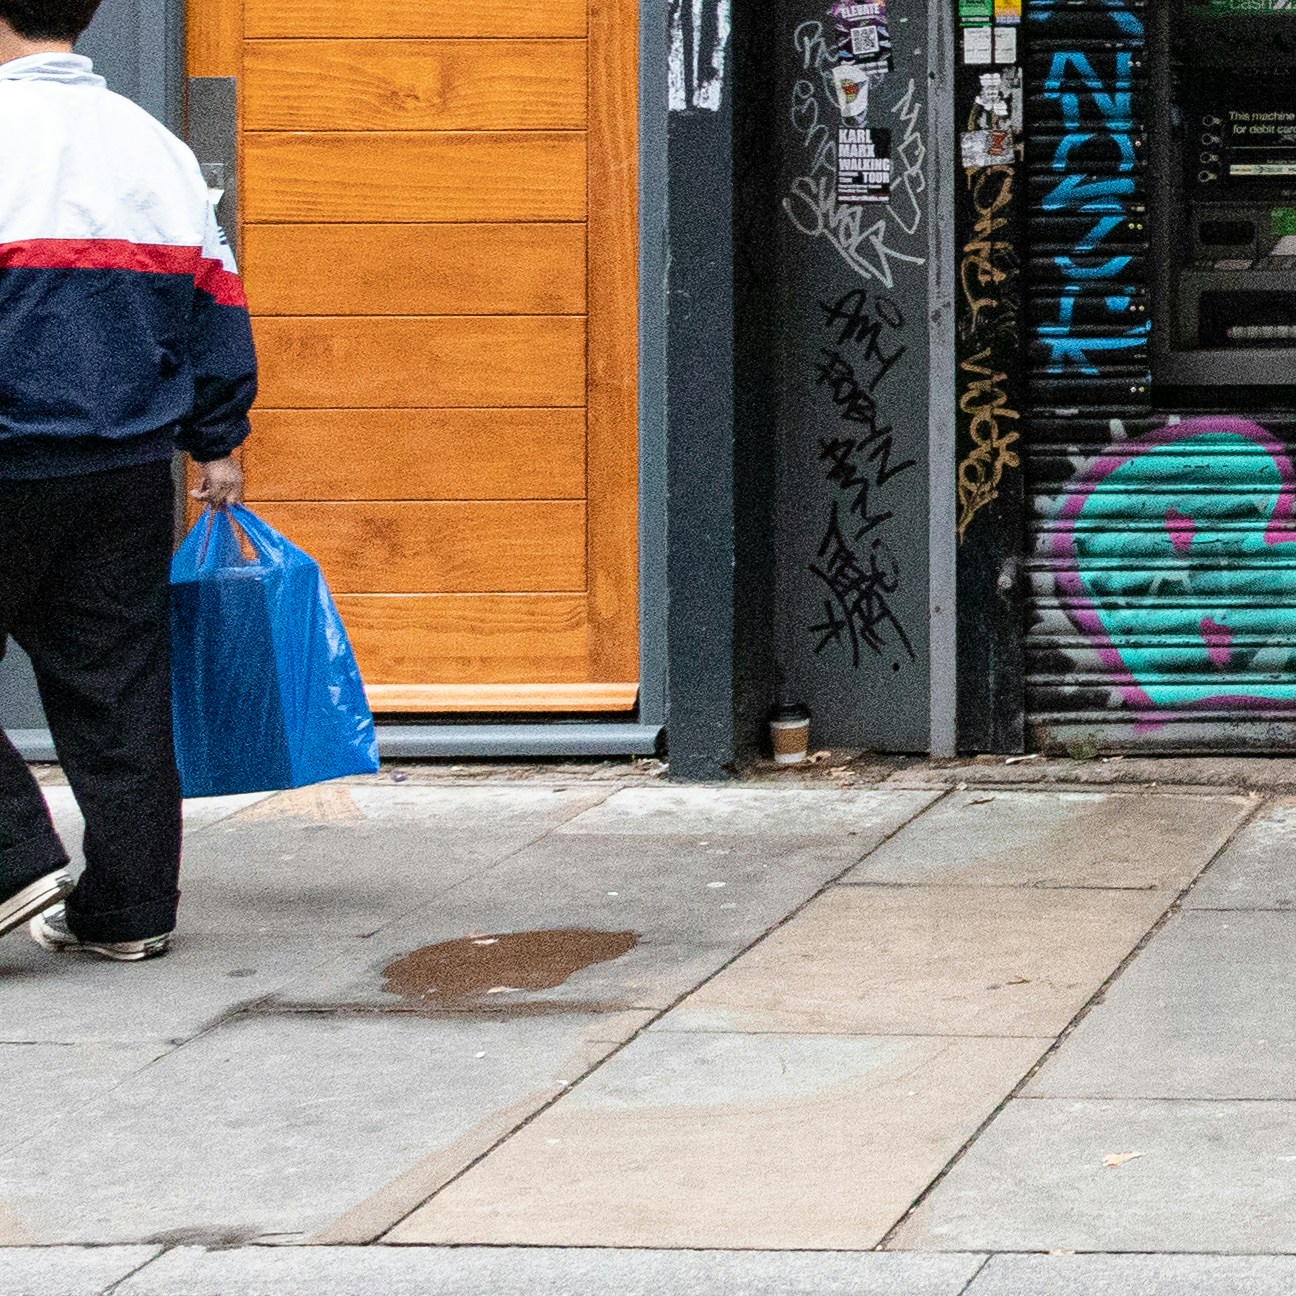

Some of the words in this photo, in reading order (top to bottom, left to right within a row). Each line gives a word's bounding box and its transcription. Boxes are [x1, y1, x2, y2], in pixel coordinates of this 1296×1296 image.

[1229, 110, 1250, 121] This
[1251, 110, 1295, 121] machine
[1233, 124, 1247, 134] for
[1250, 124, 1275, 134] debit
[839, 158, 890, 172] WALKING
[862, 171, 890, 184] TOUR
